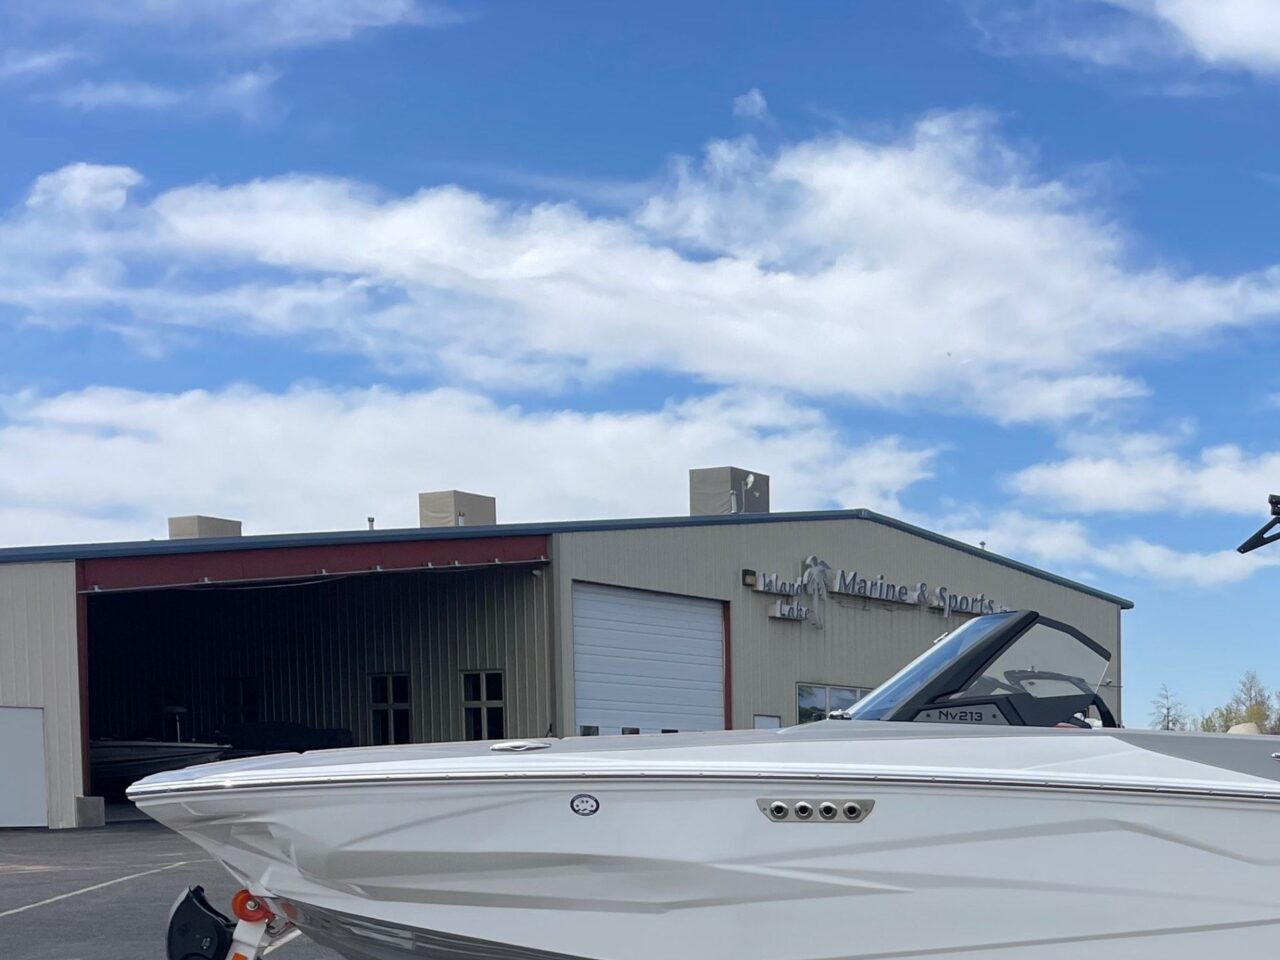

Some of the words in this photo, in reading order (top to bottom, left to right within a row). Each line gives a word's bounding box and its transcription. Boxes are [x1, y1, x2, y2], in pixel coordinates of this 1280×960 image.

[762, 572, 806, 597] Island
[838, 569, 908, 602] Marine
[916, 582, 929, 604] &
[937, 586, 994, 618] Sports
[779, 599, 810, 620] Lake
[938, 710, 983, 721] Nv213
